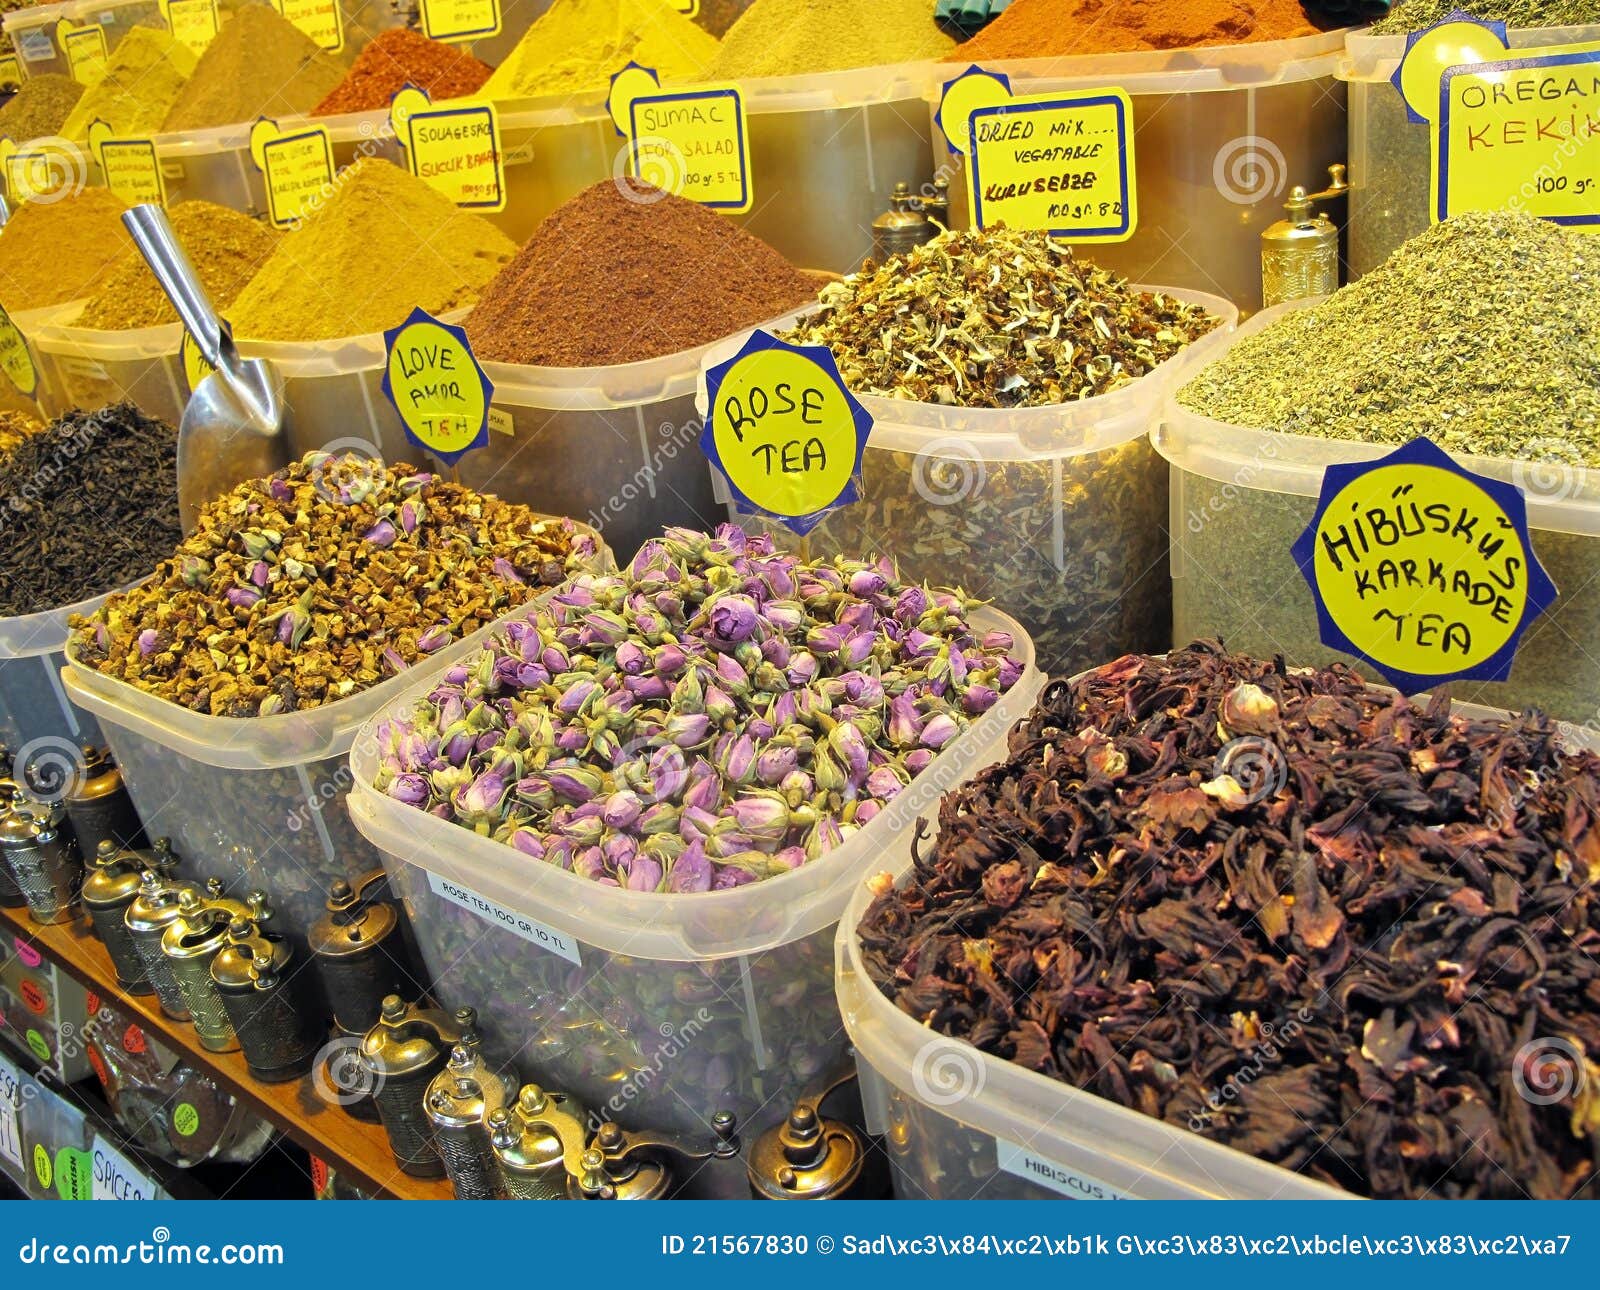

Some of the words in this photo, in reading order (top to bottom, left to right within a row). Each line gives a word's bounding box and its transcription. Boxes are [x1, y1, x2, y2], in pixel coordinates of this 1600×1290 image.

[644, 107, 724, 131] SUMAC
[978, 120, 1034, 143] DRIED
[683, 138, 734, 157] SALAD
[1014, 143, 1102, 163] VEGATABLE
[717, 172, 725, 184] 5
[1536, 176, 1568, 195] 100
[397, 344, 455, 380] LOVE
[409, 381, 466, 409] AMOR
[725, 383, 825, 443] ROSE
[751, 437, 827, 476] TEA
[1354, 558, 1513, 624] KARKADE
[1372, 608, 1472, 656] TEA
[442, 882, 470, 903] ROSE
[471, 896, 491, 914] TEA
[494, 908, 515, 925] 100
[518, 920, 533, 935] GR
[535, 928, 549, 941] 10
[551, 936, 566, 951] TL
[1024, 1157, 1104, 1200] HIBISCUS
